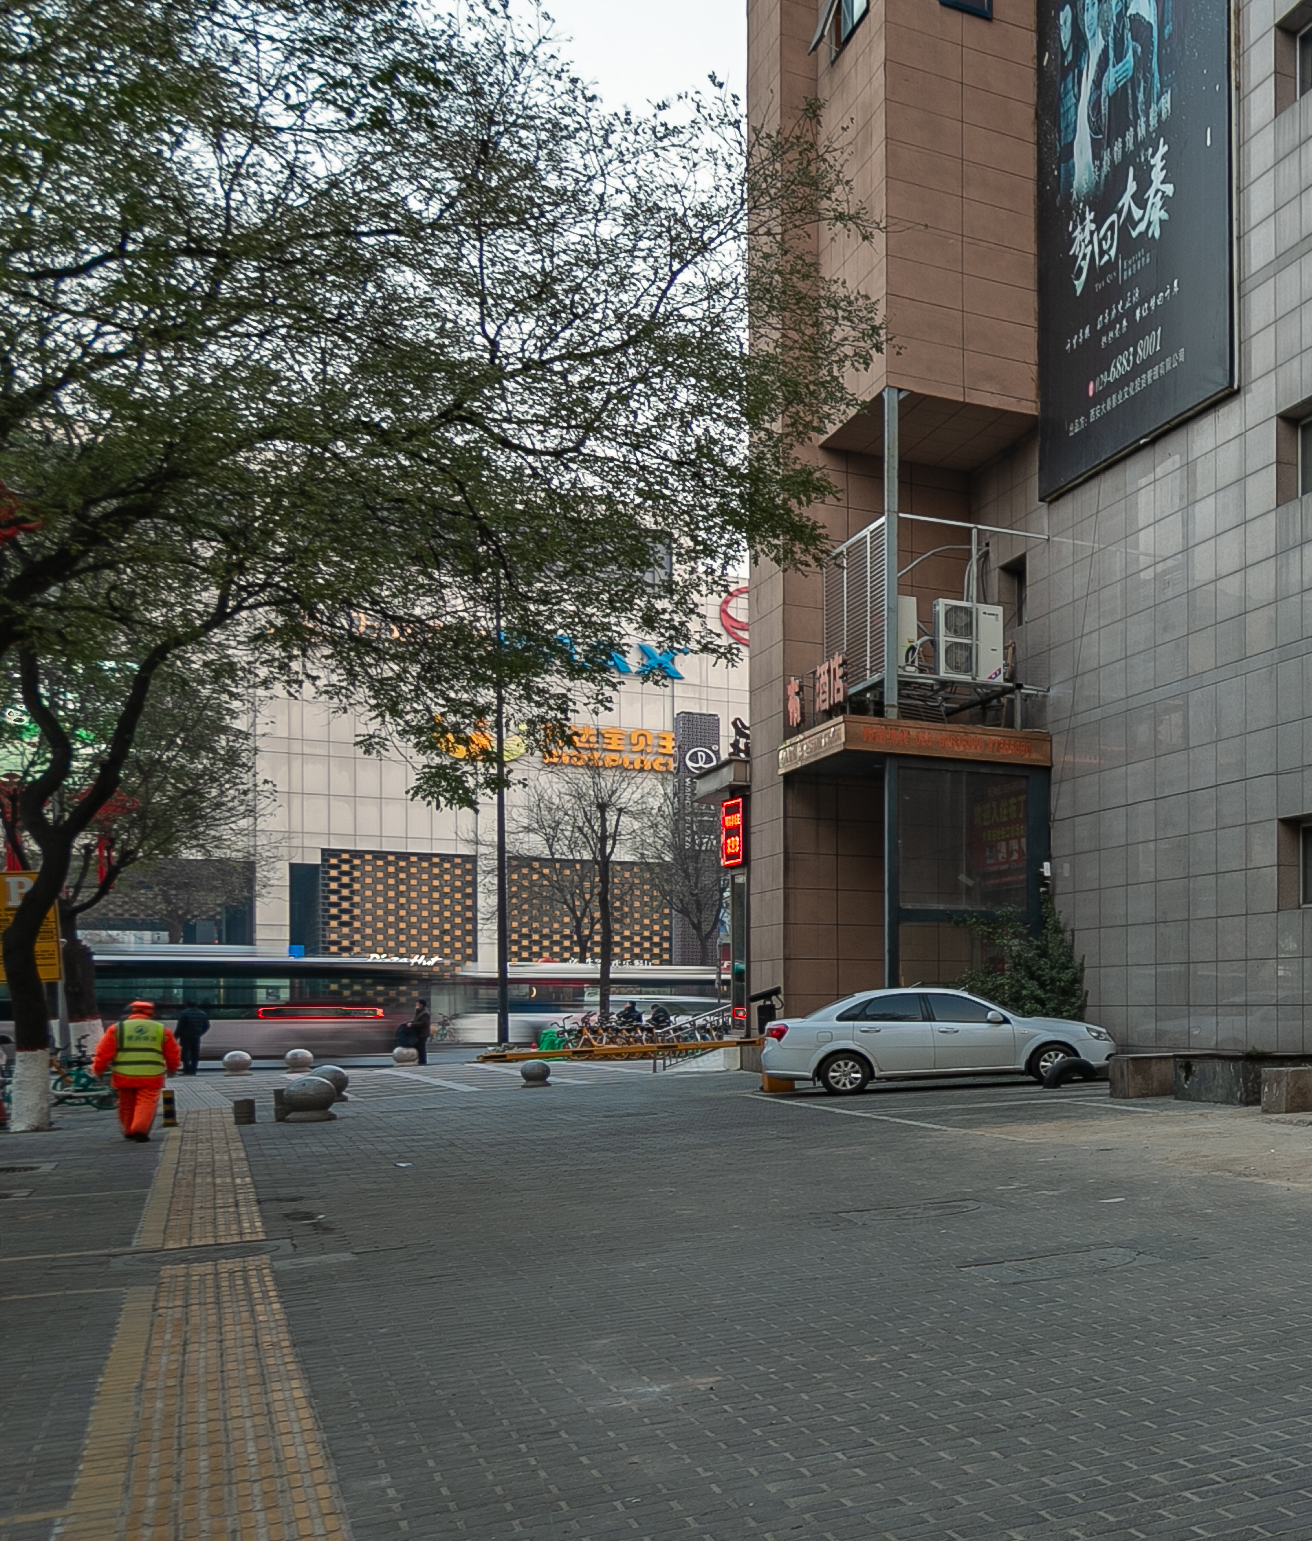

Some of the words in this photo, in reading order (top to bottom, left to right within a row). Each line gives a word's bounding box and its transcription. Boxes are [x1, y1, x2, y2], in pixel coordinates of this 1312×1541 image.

[1069, 137, 1175, 297] 梦回大秦
[1136, 326, 1163, 364] 8001
[541, 724, 675, 755] 达宝贝王
